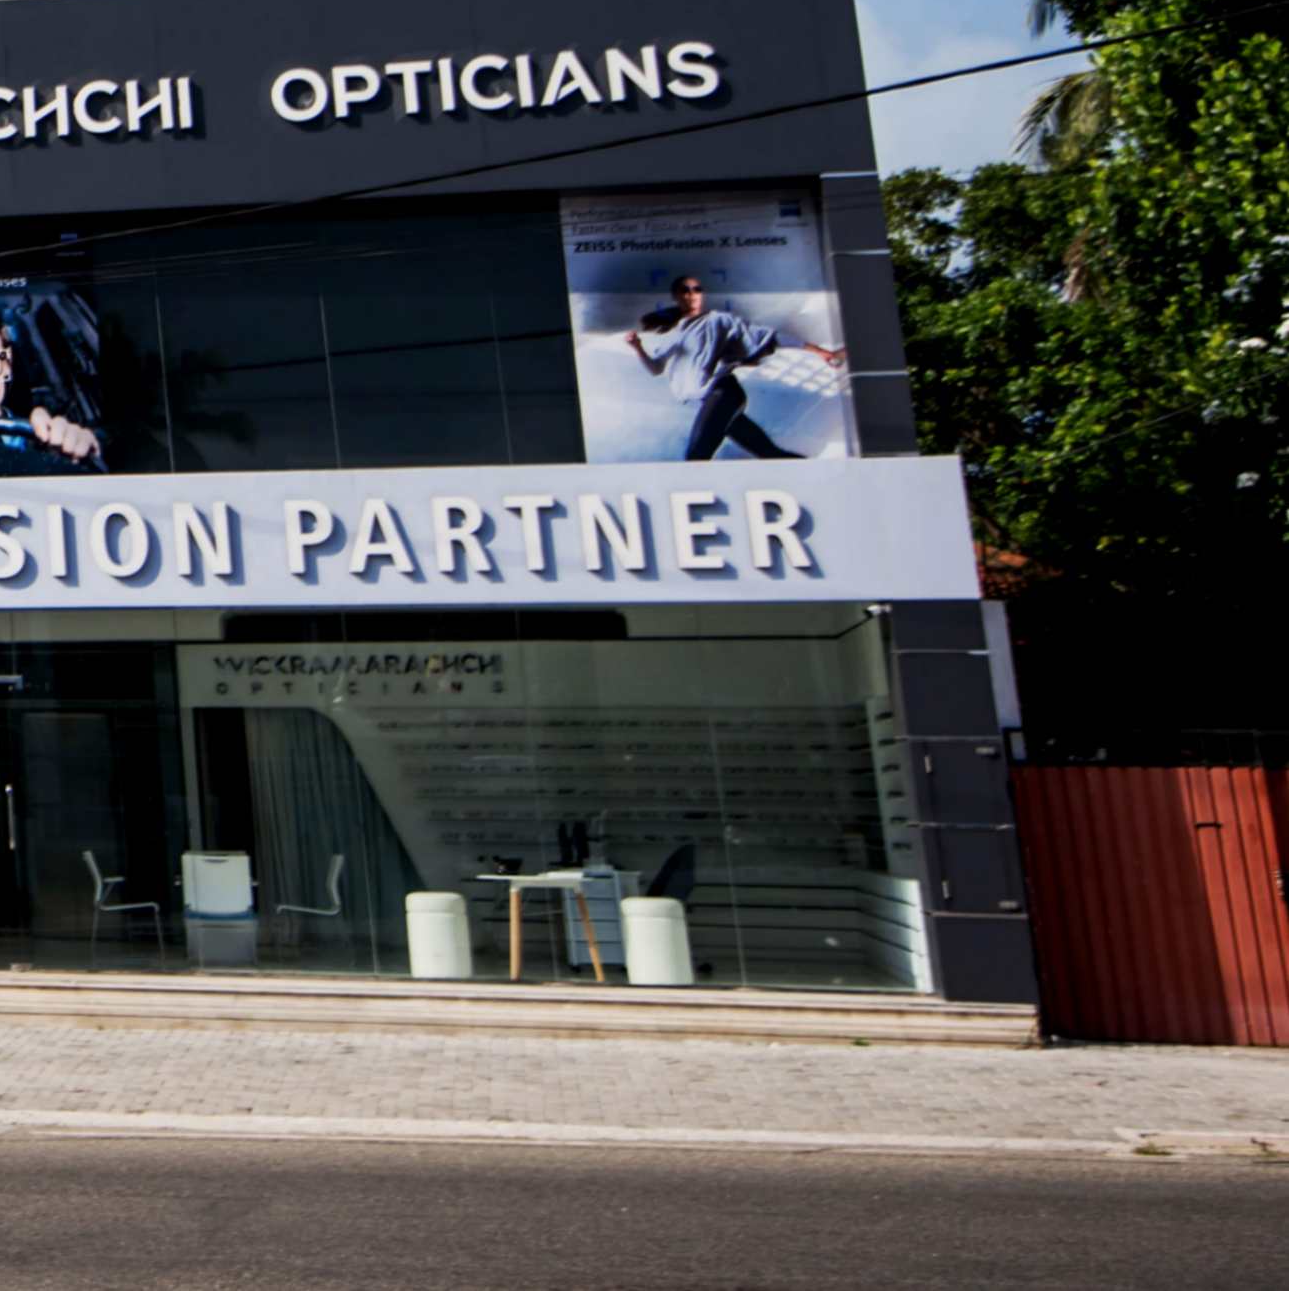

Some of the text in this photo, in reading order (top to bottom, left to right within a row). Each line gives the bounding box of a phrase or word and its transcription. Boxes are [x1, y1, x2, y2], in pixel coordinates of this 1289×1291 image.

[270, 41, 721, 123] OPTICIANS
[573, 235, 788, 253] ZEISS PhotoFusion X Lenses
[283, 489, 814, 575] PARTNER
